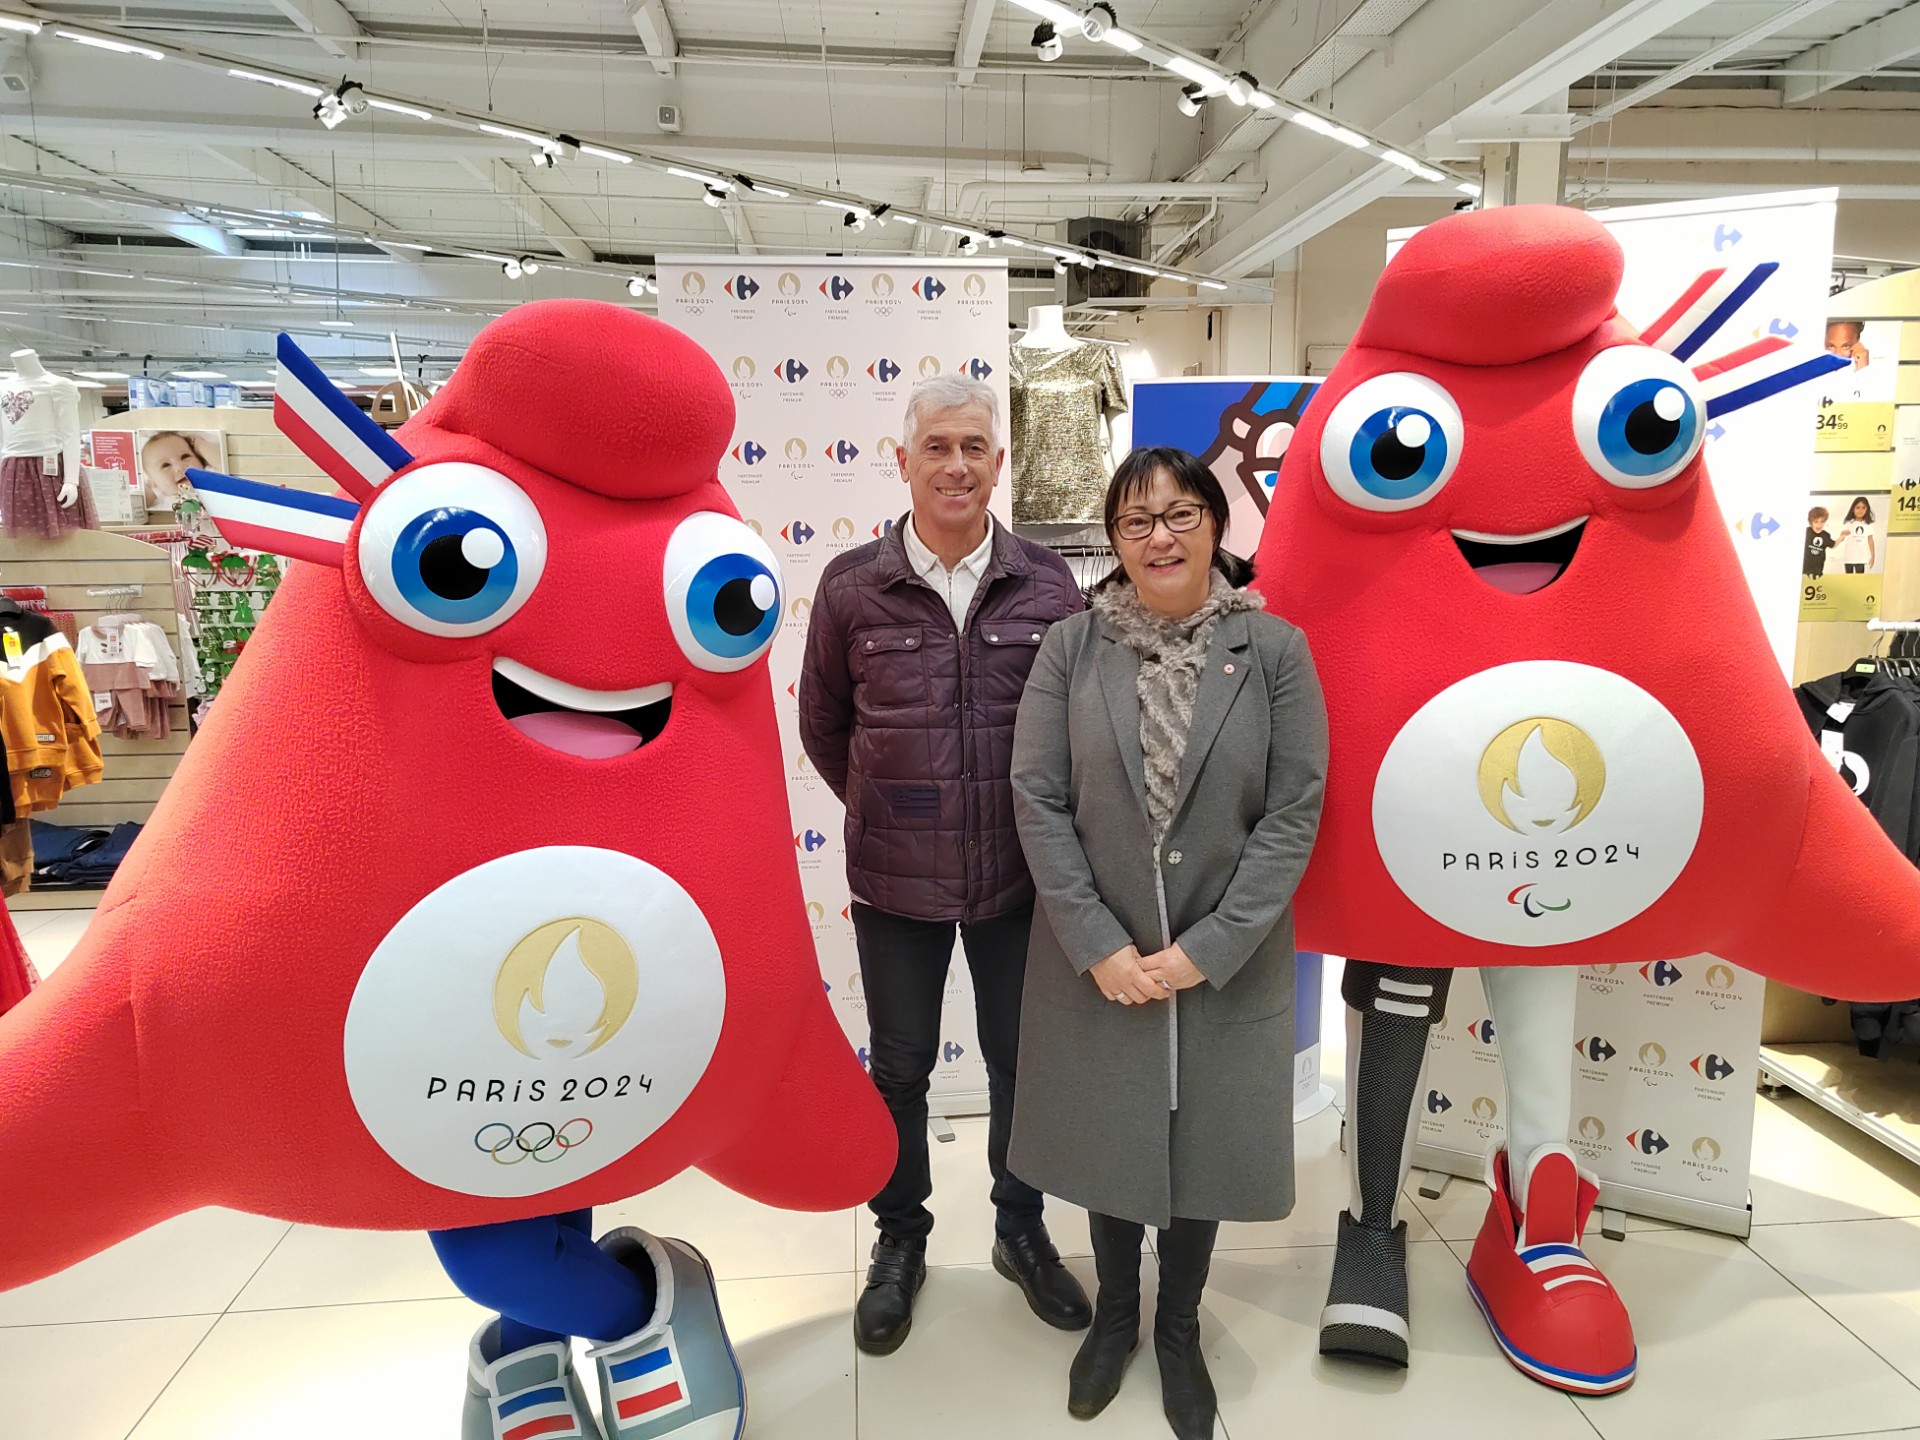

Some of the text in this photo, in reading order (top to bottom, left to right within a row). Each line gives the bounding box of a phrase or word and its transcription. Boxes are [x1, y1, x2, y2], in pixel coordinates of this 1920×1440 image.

[1554, 843, 1640, 868] 2024
[559, 1074, 653, 1102] 2024
[1420, 1119, 1446, 1128] ARTENAIRE
